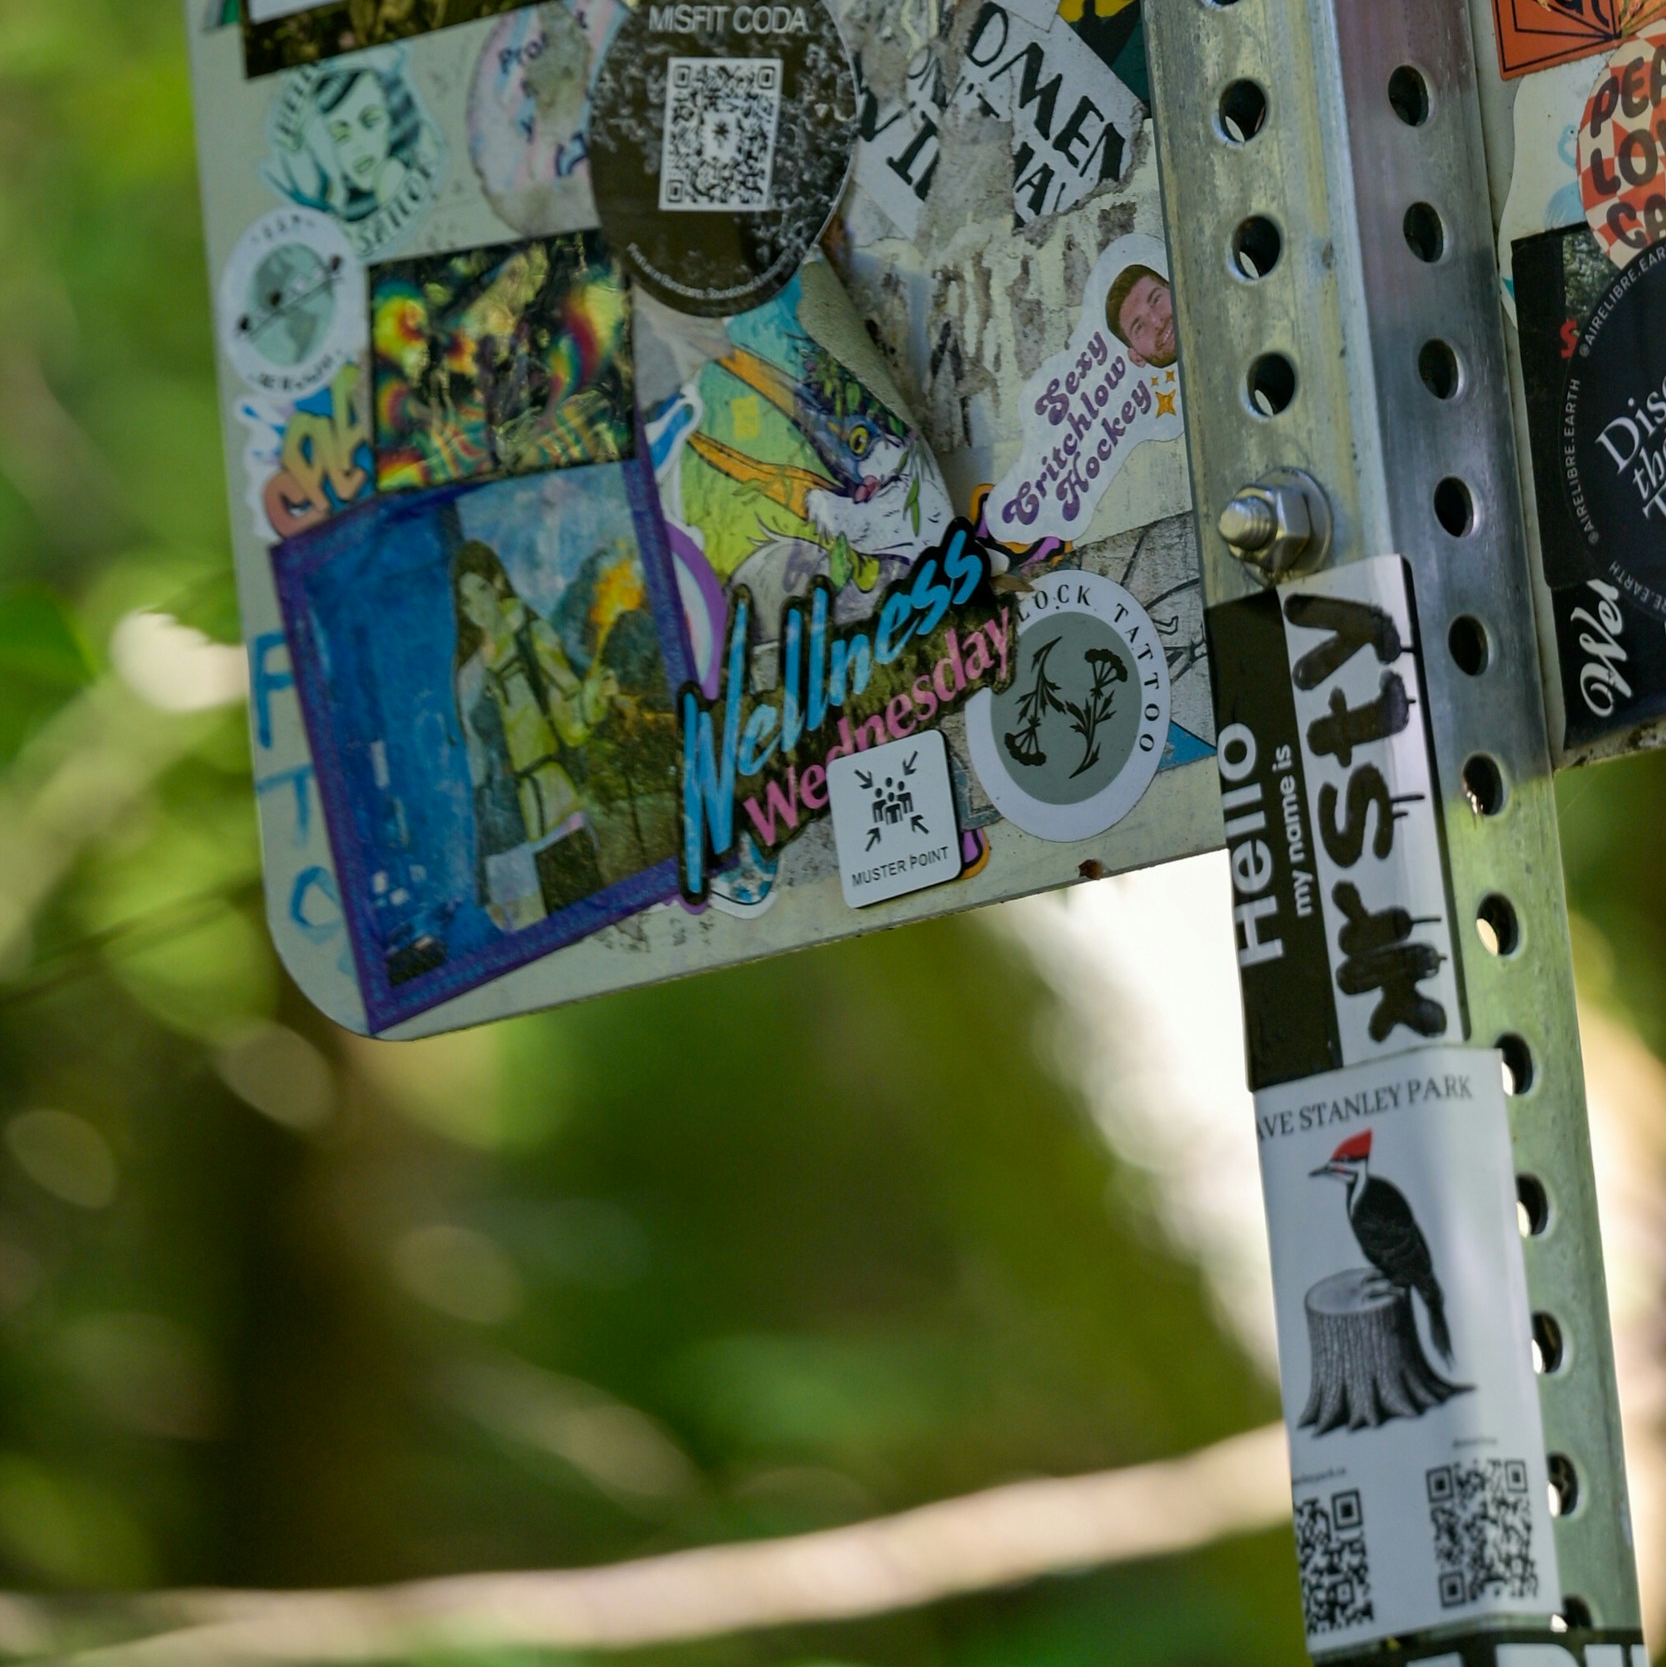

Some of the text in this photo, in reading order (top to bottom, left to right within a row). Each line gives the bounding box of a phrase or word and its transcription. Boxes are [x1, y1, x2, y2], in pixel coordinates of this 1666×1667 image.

[647, 4, 811, 36] MISFIT CODA
[1002, 354, 1127, 527] Critchlow
[1034, 330, 1109, 427] Sexy
[1057, 380, 1153, 524] Hockey
[1565, 377, 1600, 545] @AIRELIBRE.EARTH
[682, 528, 984, 895] Wellness
[743, 607, 1013, 848] Wednesday
[1115, 601, 1160, 756] TATTOO
[851, 844, 950, 889] MUSTER POINT
[1216, 721, 1286, 969] Hello
[1272, 743, 1314, 919] my name is
[1298, 1085, 1403, 1132] STANLEY
[1406, 1073, 1475, 1106] PARK
